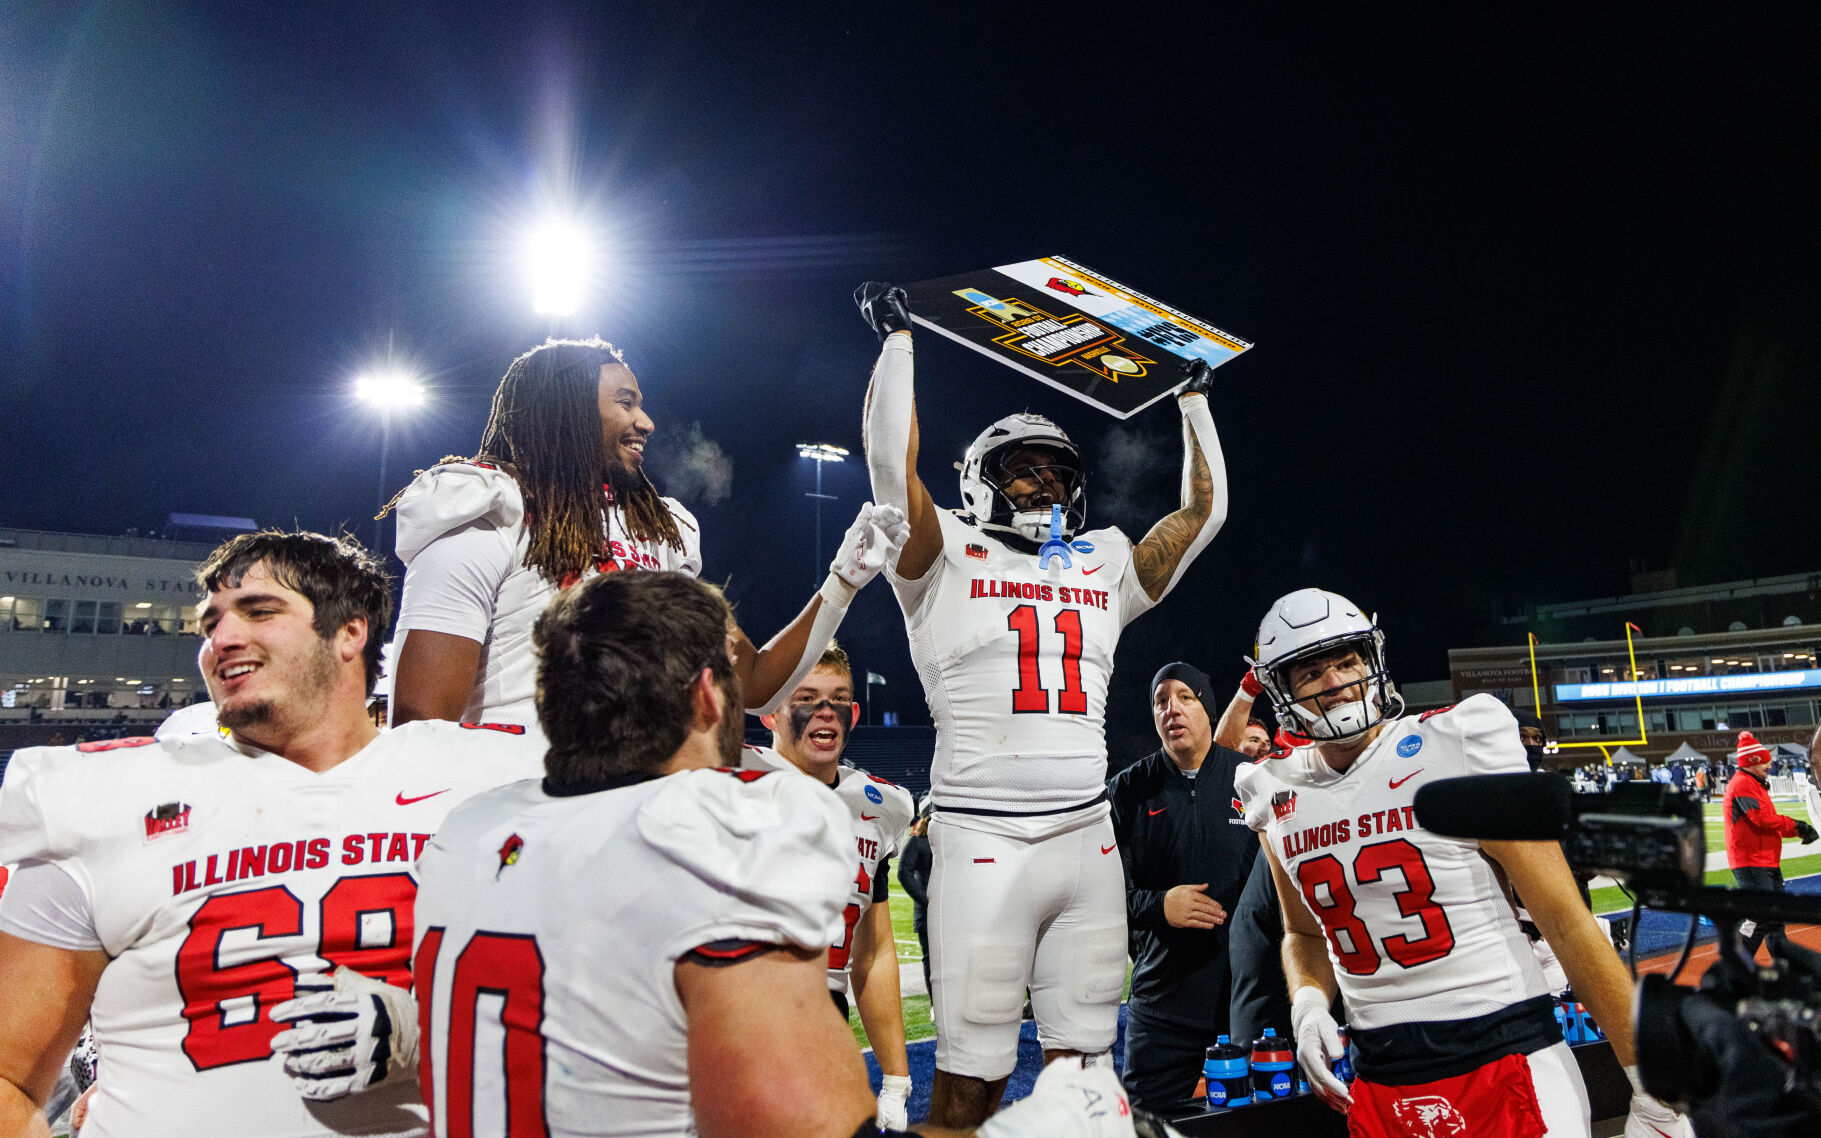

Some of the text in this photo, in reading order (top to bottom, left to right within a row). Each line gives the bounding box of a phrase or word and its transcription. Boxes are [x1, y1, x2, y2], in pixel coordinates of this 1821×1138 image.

[1017, 318, 1068, 339] FOOTBALL
[1021, 322, 1105, 357] CHAMPIONSHIP
[6, 571, 198, 593] VILLANOVA STAD
[970, 579, 1109, 611] ILLINOIS STATE
[1007, 603, 1088, 716] 11
[1666, 677, 1719, 693] FOOTBALL
[1720, 672, 1805, 690] CHAMPIONSHIP
[144, 807, 192, 836] VALLEY
[1282, 805, 1415, 860] ILLINOIS STAT
[856, 835, 878, 861] ATE
[172, 832, 435, 897] ILLINOIS STAT
[1296, 837, 1456, 976] 83
[1209, 1091, 1227, 1099] NCAA
[1273, 1082, 1291, 1091] NCAA
